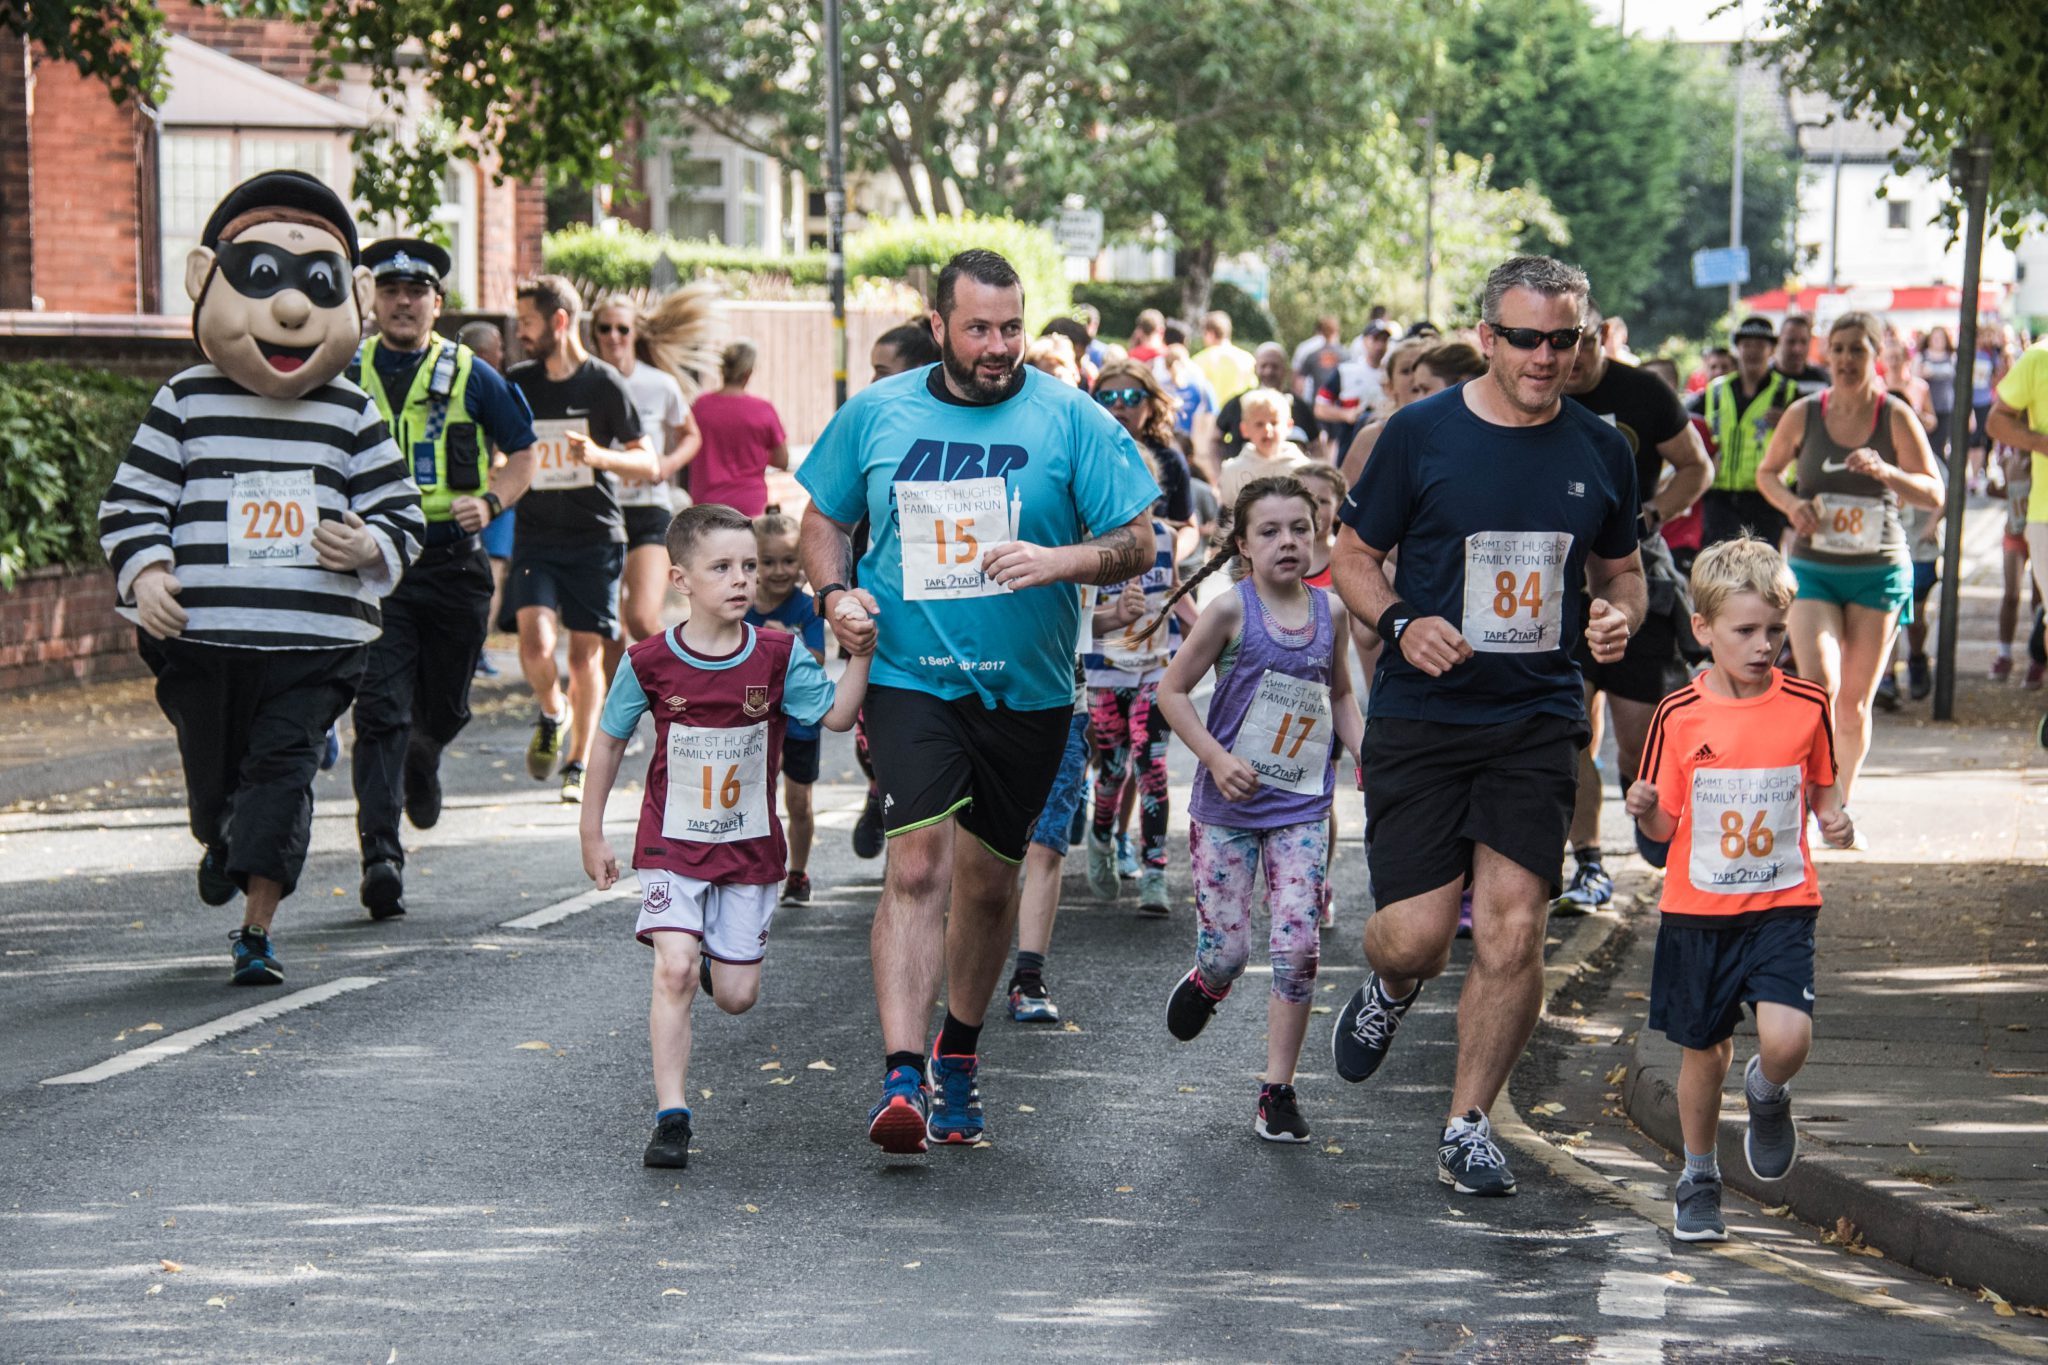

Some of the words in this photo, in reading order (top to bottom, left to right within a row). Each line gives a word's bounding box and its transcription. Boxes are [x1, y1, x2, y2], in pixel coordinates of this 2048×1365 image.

[232, 488, 266, 498] FAMILY
[268, 488, 286, 497] FUN
[289, 487, 311, 497] RUN
[934, 489, 950, 501] ST
[953, 485, 1002, 500] HUGH'S
[904, 503, 943, 514] FAMILY
[947, 502, 971, 513] FUN
[974, 500, 1001, 511] RUN
[241, 501, 304, 538] 220
[1833, 506, 1864, 536] 68
[934, 518, 979, 565] 15
[1482, 540, 1501, 548] HMT
[1504, 540, 1519, 552] ST
[1472, 553, 1512, 565] FAMILY
[1515, 555, 1540, 566] FUN
[1543, 554, 1563, 566] RUN
[924, 574, 980, 590] TAPE2TAPE
[1493, 570, 1543, 619] 84
[1483, 628, 1539, 644] TAPE2TAPE
[919, 656, 927, 666] 3
[978, 660, 1006, 671] 2017
[1274, 680, 1292, 690] HMT
[1294, 687, 1307, 697] ST
[1260, 690, 1296, 708] FAMILY
[1298, 700, 1318, 713] FUN
[704, 736, 720, 747] ST
[1271, 712, 1317, 759] 17
[672, 746, 713, 760] FAMILY
[716, 749, 741, 760] FUN
[743, 742, 763, 758] RUN
[1250, 759, 1297, 781] TAPE2TAPE
[703, 764, 741, 809] 16
[1703, 778, 1722, 786] HMT
[1727, 778, 1744, 791] ST
[1749, 774, 1798, 790] HUGH'S
[1696, 791, 1737, 804] FAMILY
[1741, 793, 1768, 804] FUN
[1772, 790, 1796, 802] RUN
[686, 818, 738, 834] TAPE2TAPE
[1720, 809, 1774, 860] 86
[1711, 867, 1773, 885] TAPE2TAPE
